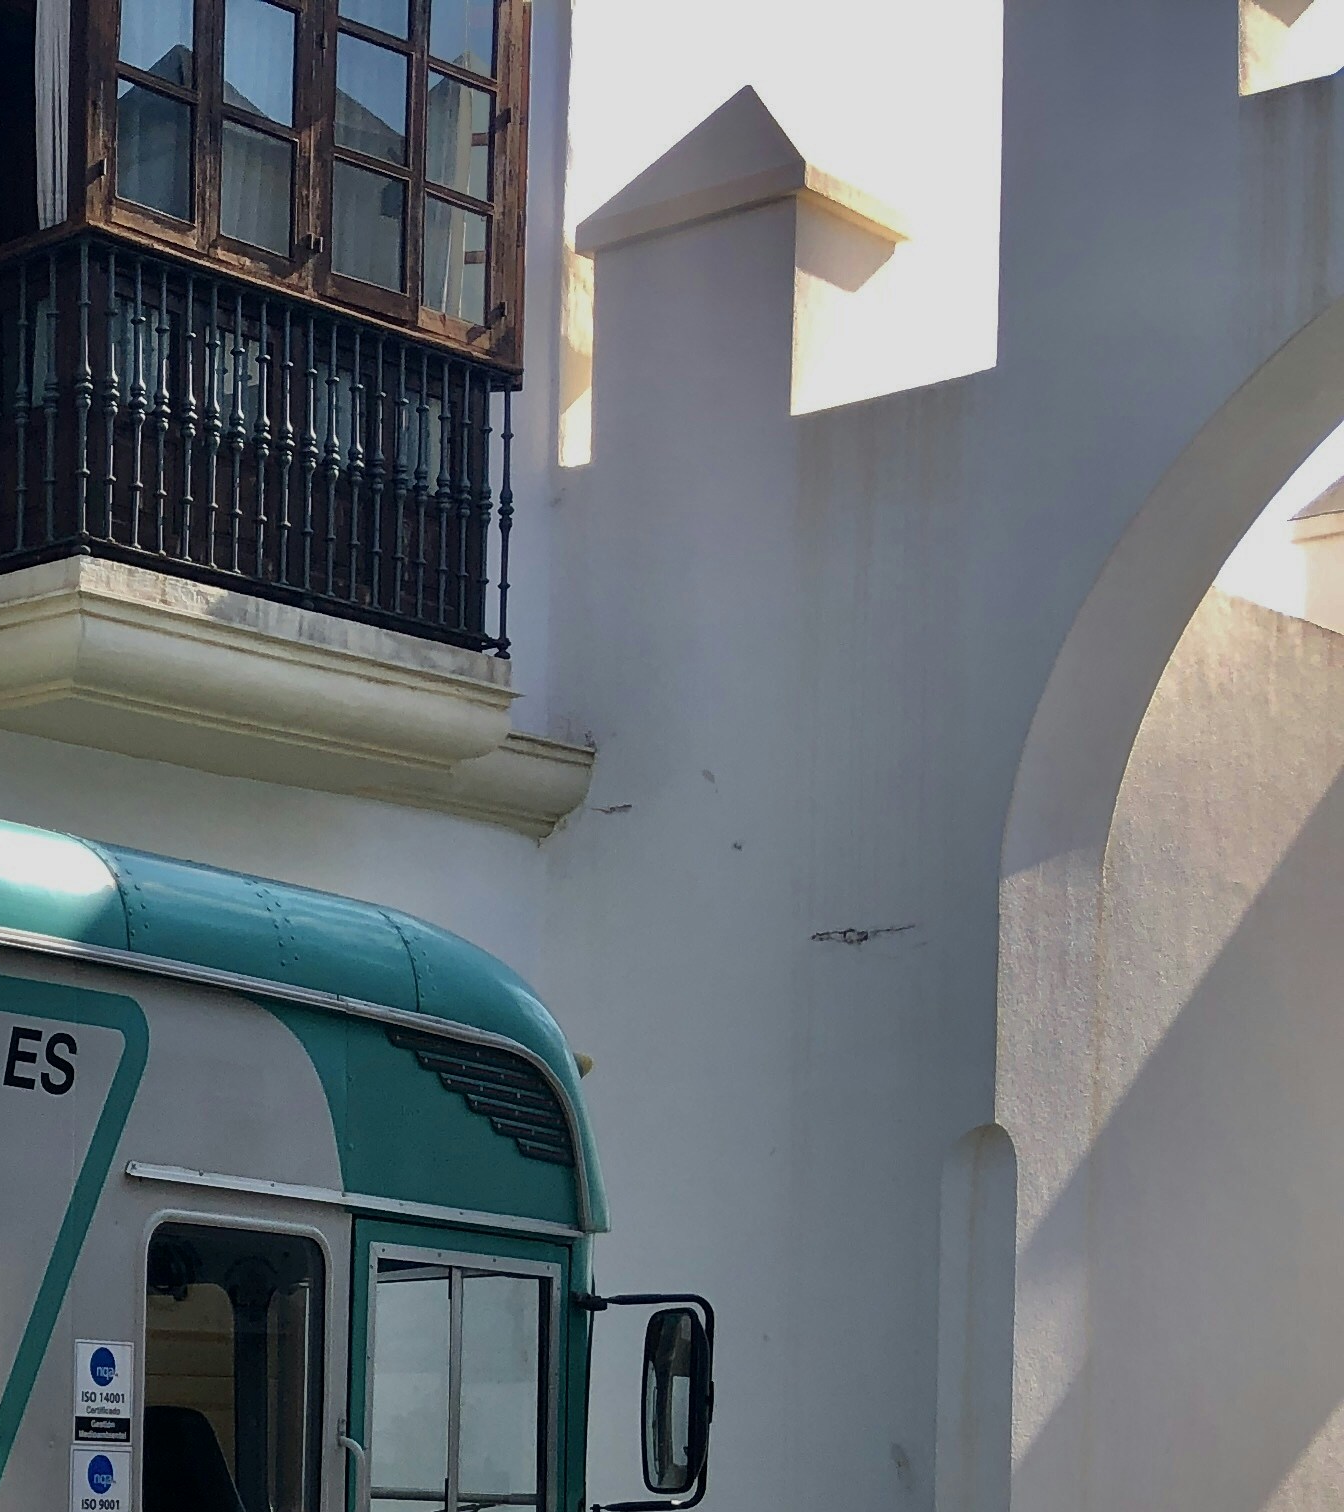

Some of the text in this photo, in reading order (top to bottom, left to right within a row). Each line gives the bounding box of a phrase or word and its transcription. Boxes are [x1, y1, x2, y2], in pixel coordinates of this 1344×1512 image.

[81, 1390, 125, 1404] ISO 14001
[86, 1405, 120, 1415] Certificado
[81, 1498, 120, 1511] ISO 9001
